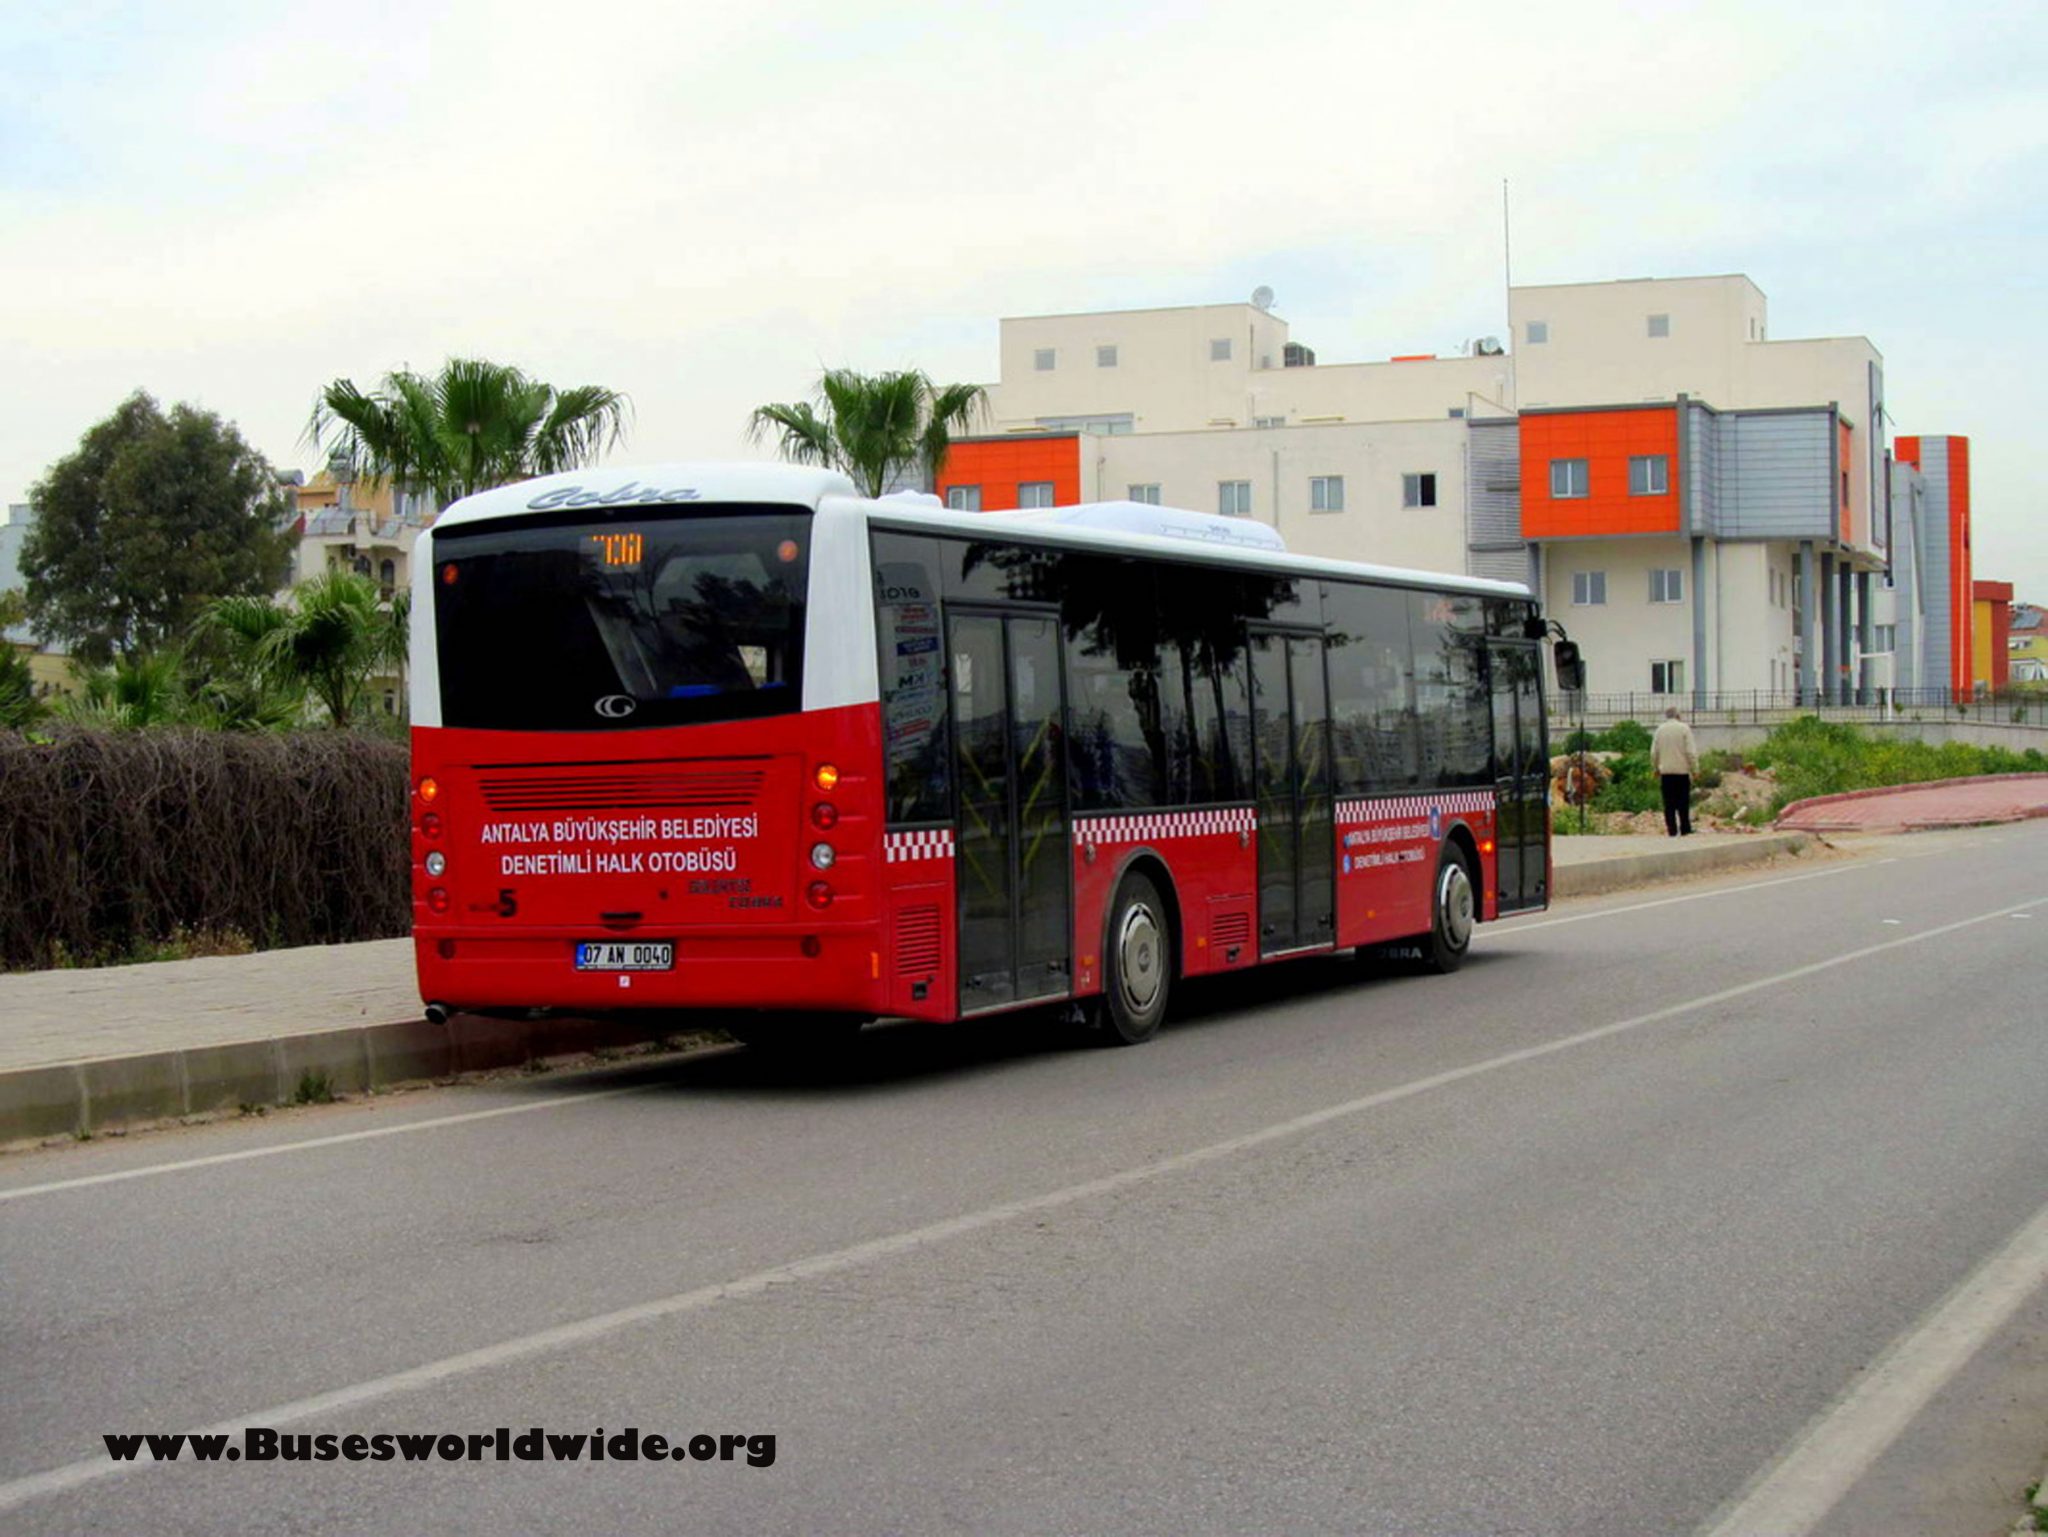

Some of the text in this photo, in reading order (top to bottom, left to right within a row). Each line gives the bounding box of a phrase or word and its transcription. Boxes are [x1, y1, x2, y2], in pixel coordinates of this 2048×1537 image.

[527, 481, 701, 510] Cobra
[481, 812, 759, 845] ANTALYA BÜYÜKŞEHİR BELEDİYESİ
[501, 846, 737, 875] DENETİMLİ HALK OTOBÜSÜ
[499, 888, 517, 918] 5
[583, 946, 670, 964] 07 AN 0040
